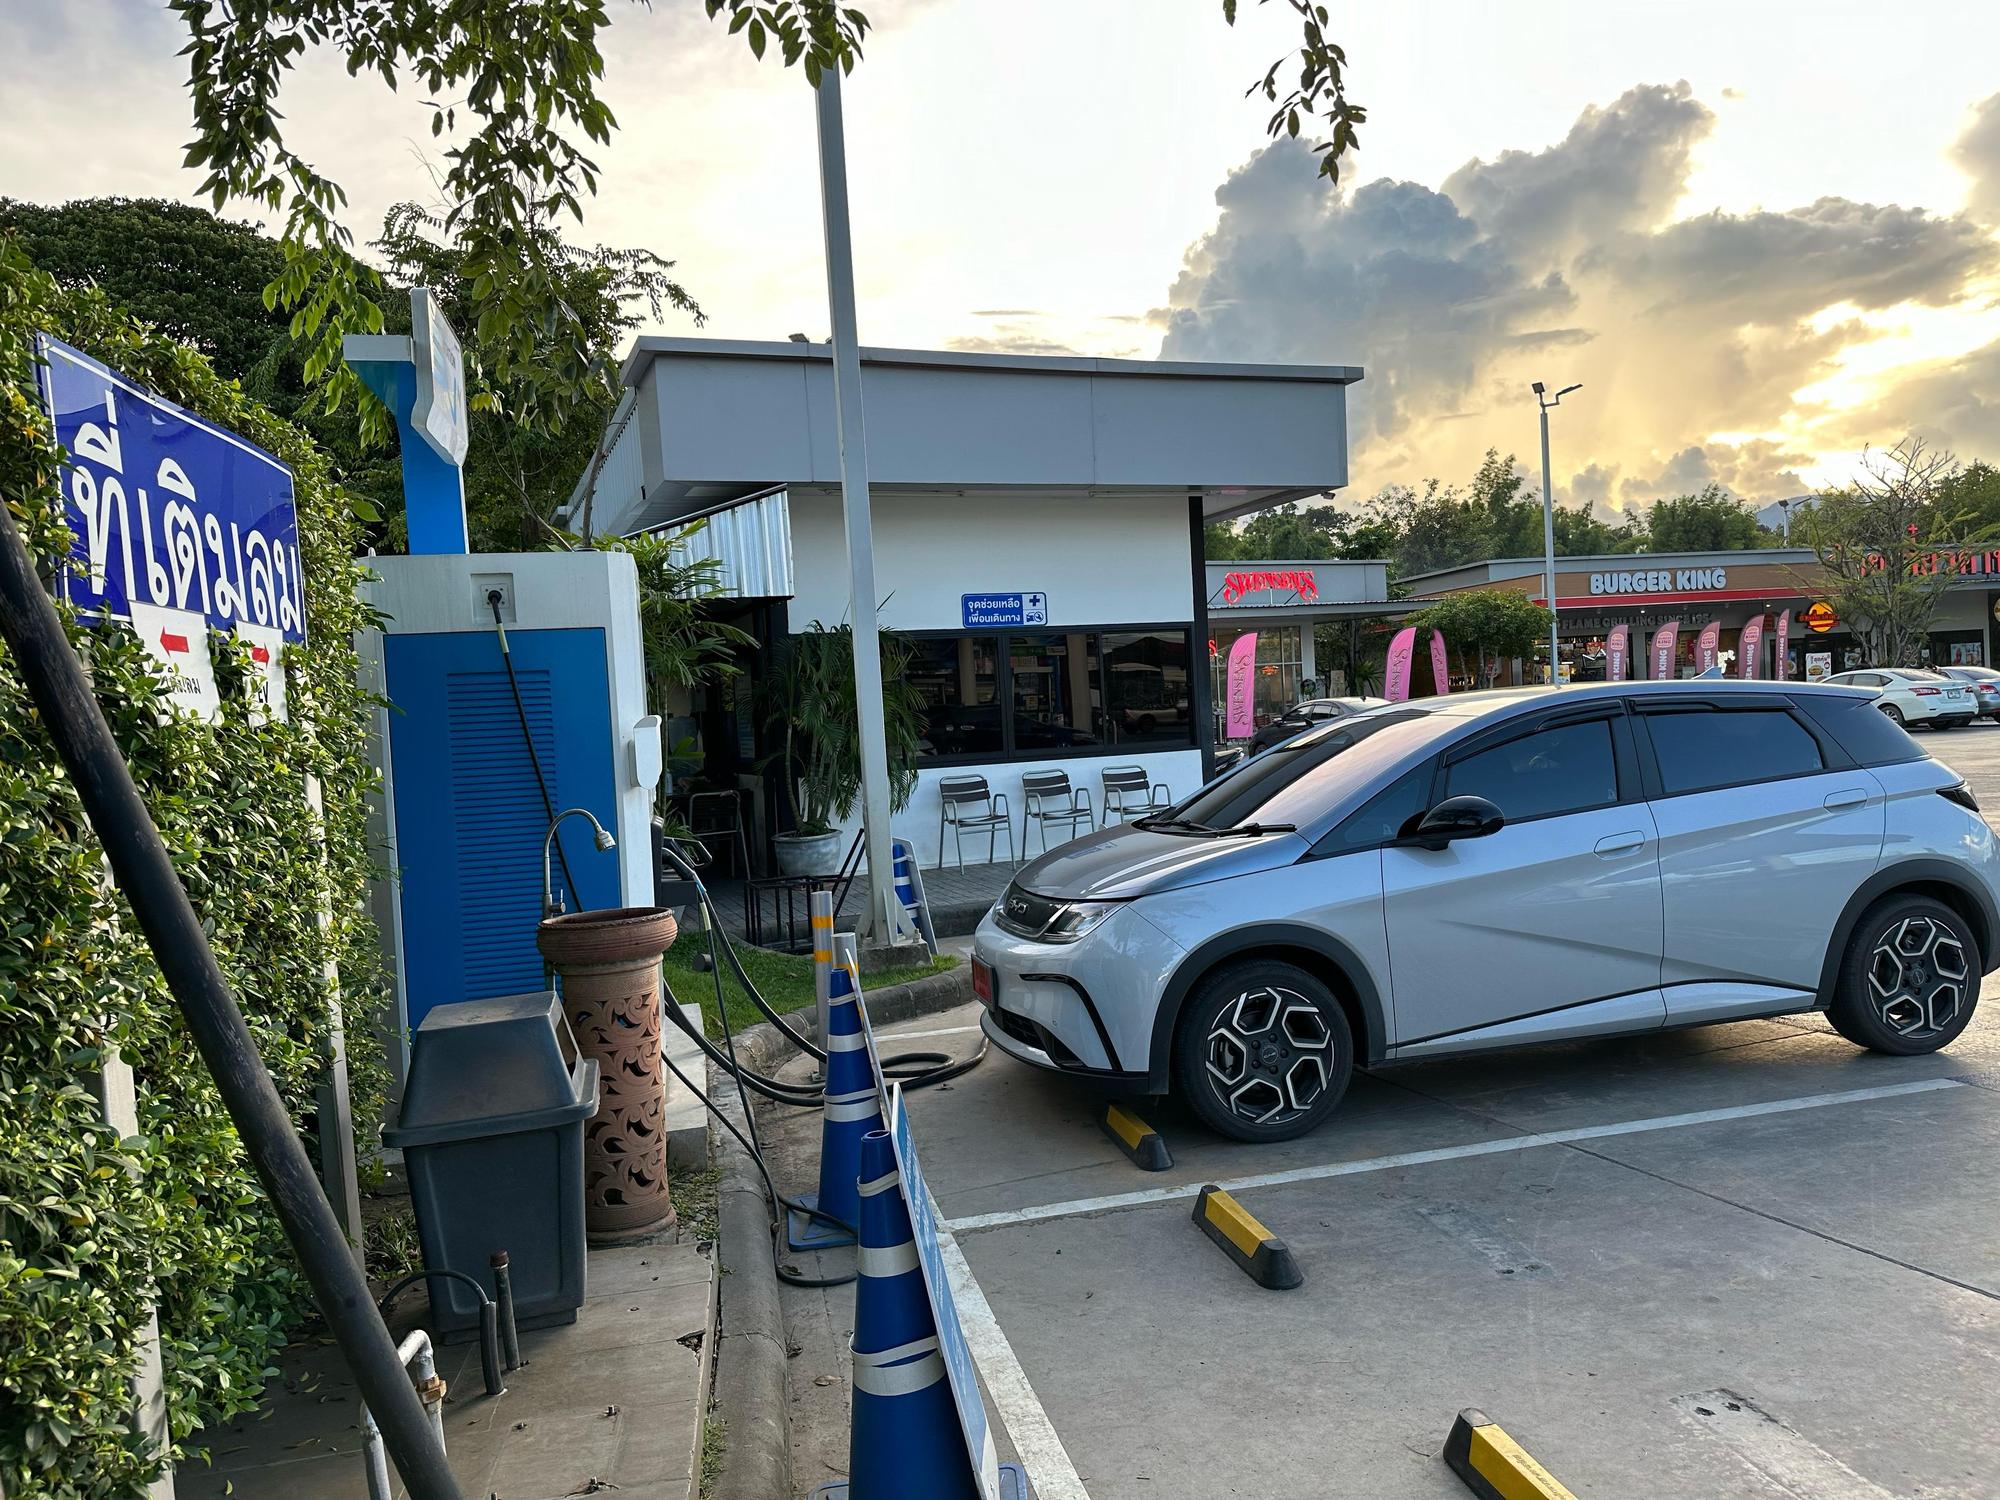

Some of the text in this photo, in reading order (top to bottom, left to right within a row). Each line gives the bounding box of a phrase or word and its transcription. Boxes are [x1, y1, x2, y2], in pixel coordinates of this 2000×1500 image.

[71, 390, 303, 633] ที่เติมลม
[1590, 567, 1727, 595] BURGER KING
[967, 598, 1021, 612] จุดช่วยเหลือ
[968, 611, 1021, 623] เพื่อนเดินทาง
[1562, 617, 1601, 630] FLAME
[1601, 614, 1656, 628] GRILLING
[1657, 613, 1690, 626] SINCE
[1613, 651, 1621, 673] KING
[1659, 649, 1668, 671] KING
[1746, 644, 1755, 666] KING
